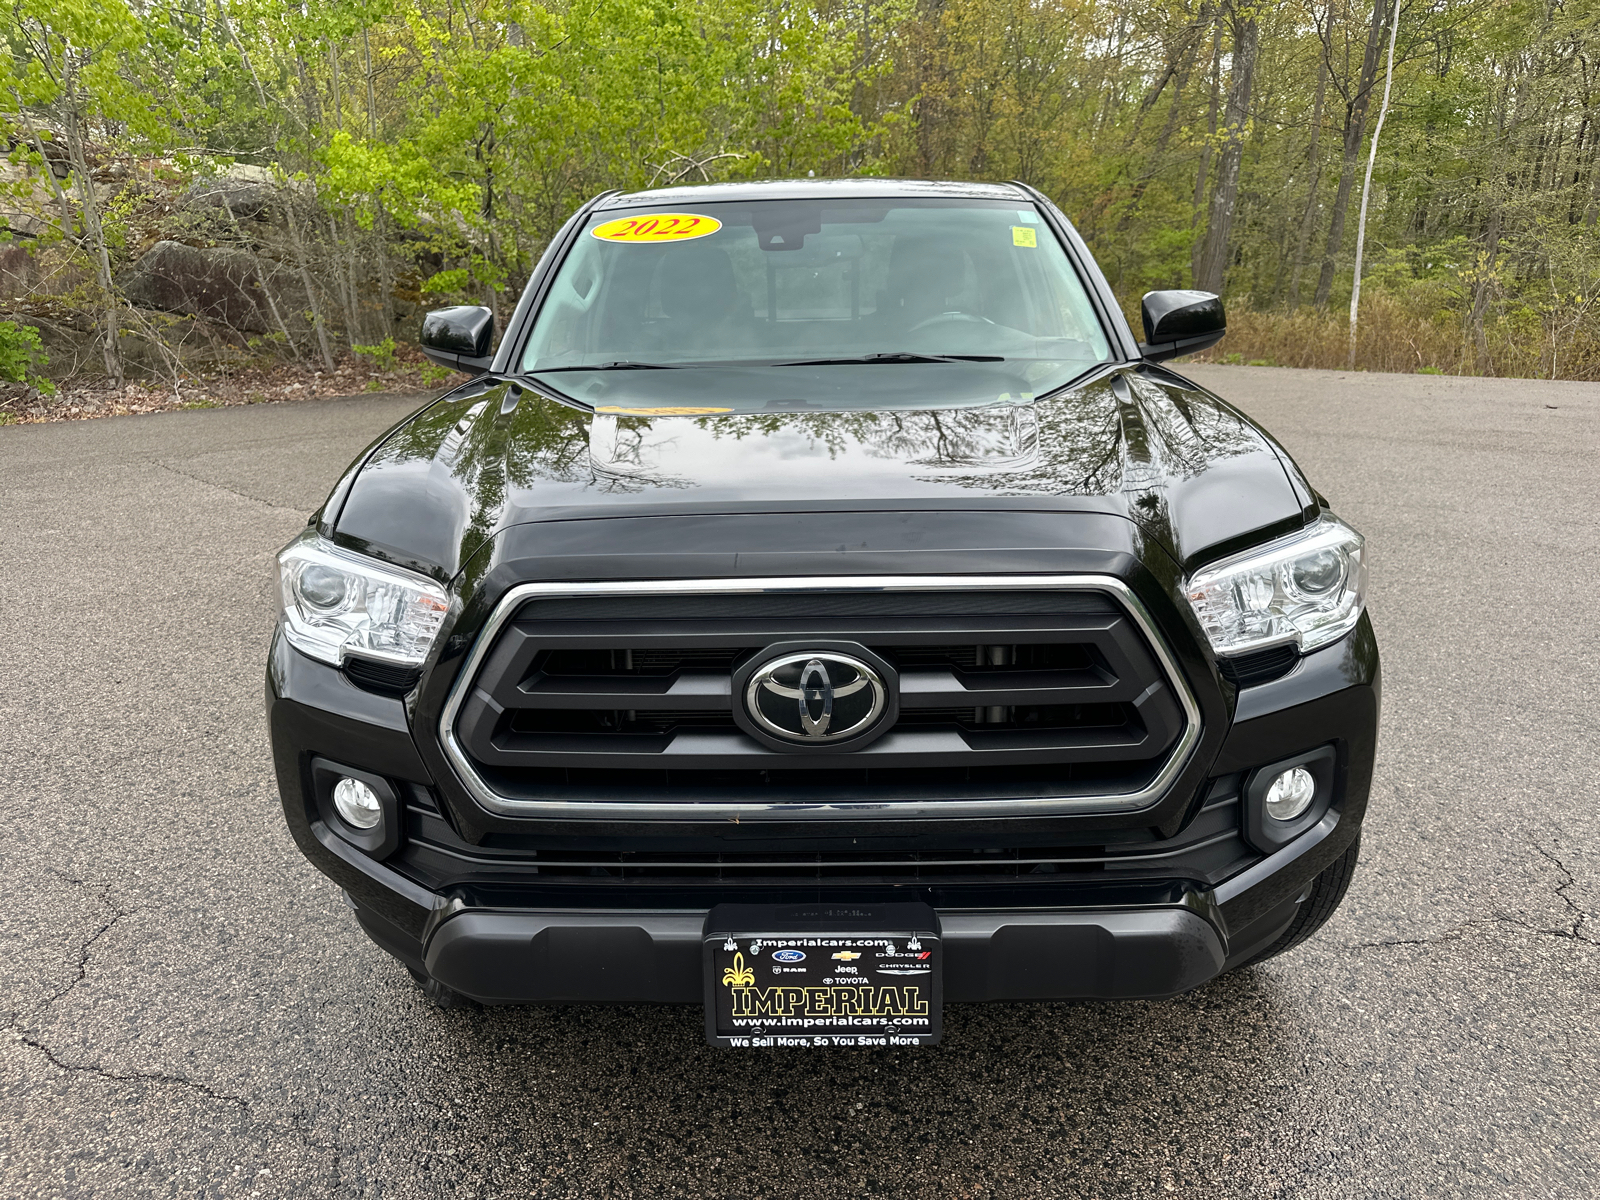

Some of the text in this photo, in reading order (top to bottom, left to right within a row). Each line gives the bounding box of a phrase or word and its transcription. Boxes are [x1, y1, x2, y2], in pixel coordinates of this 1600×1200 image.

[610, 218, 701, 237] 2022
[756, 938, 889, 948] Imperialcars.com
[779, 951, 799, 961] Ford
[834, 965, 858, 975] Jeep
[834, 977, 869, 985] TOYOTA
[731, 986, 929, 1017] IMPERIAL
[732, 1016, 929, 1028] www.imperialcars.com
[730, 1035, 920, 1048] We Sell More, So You Save More
